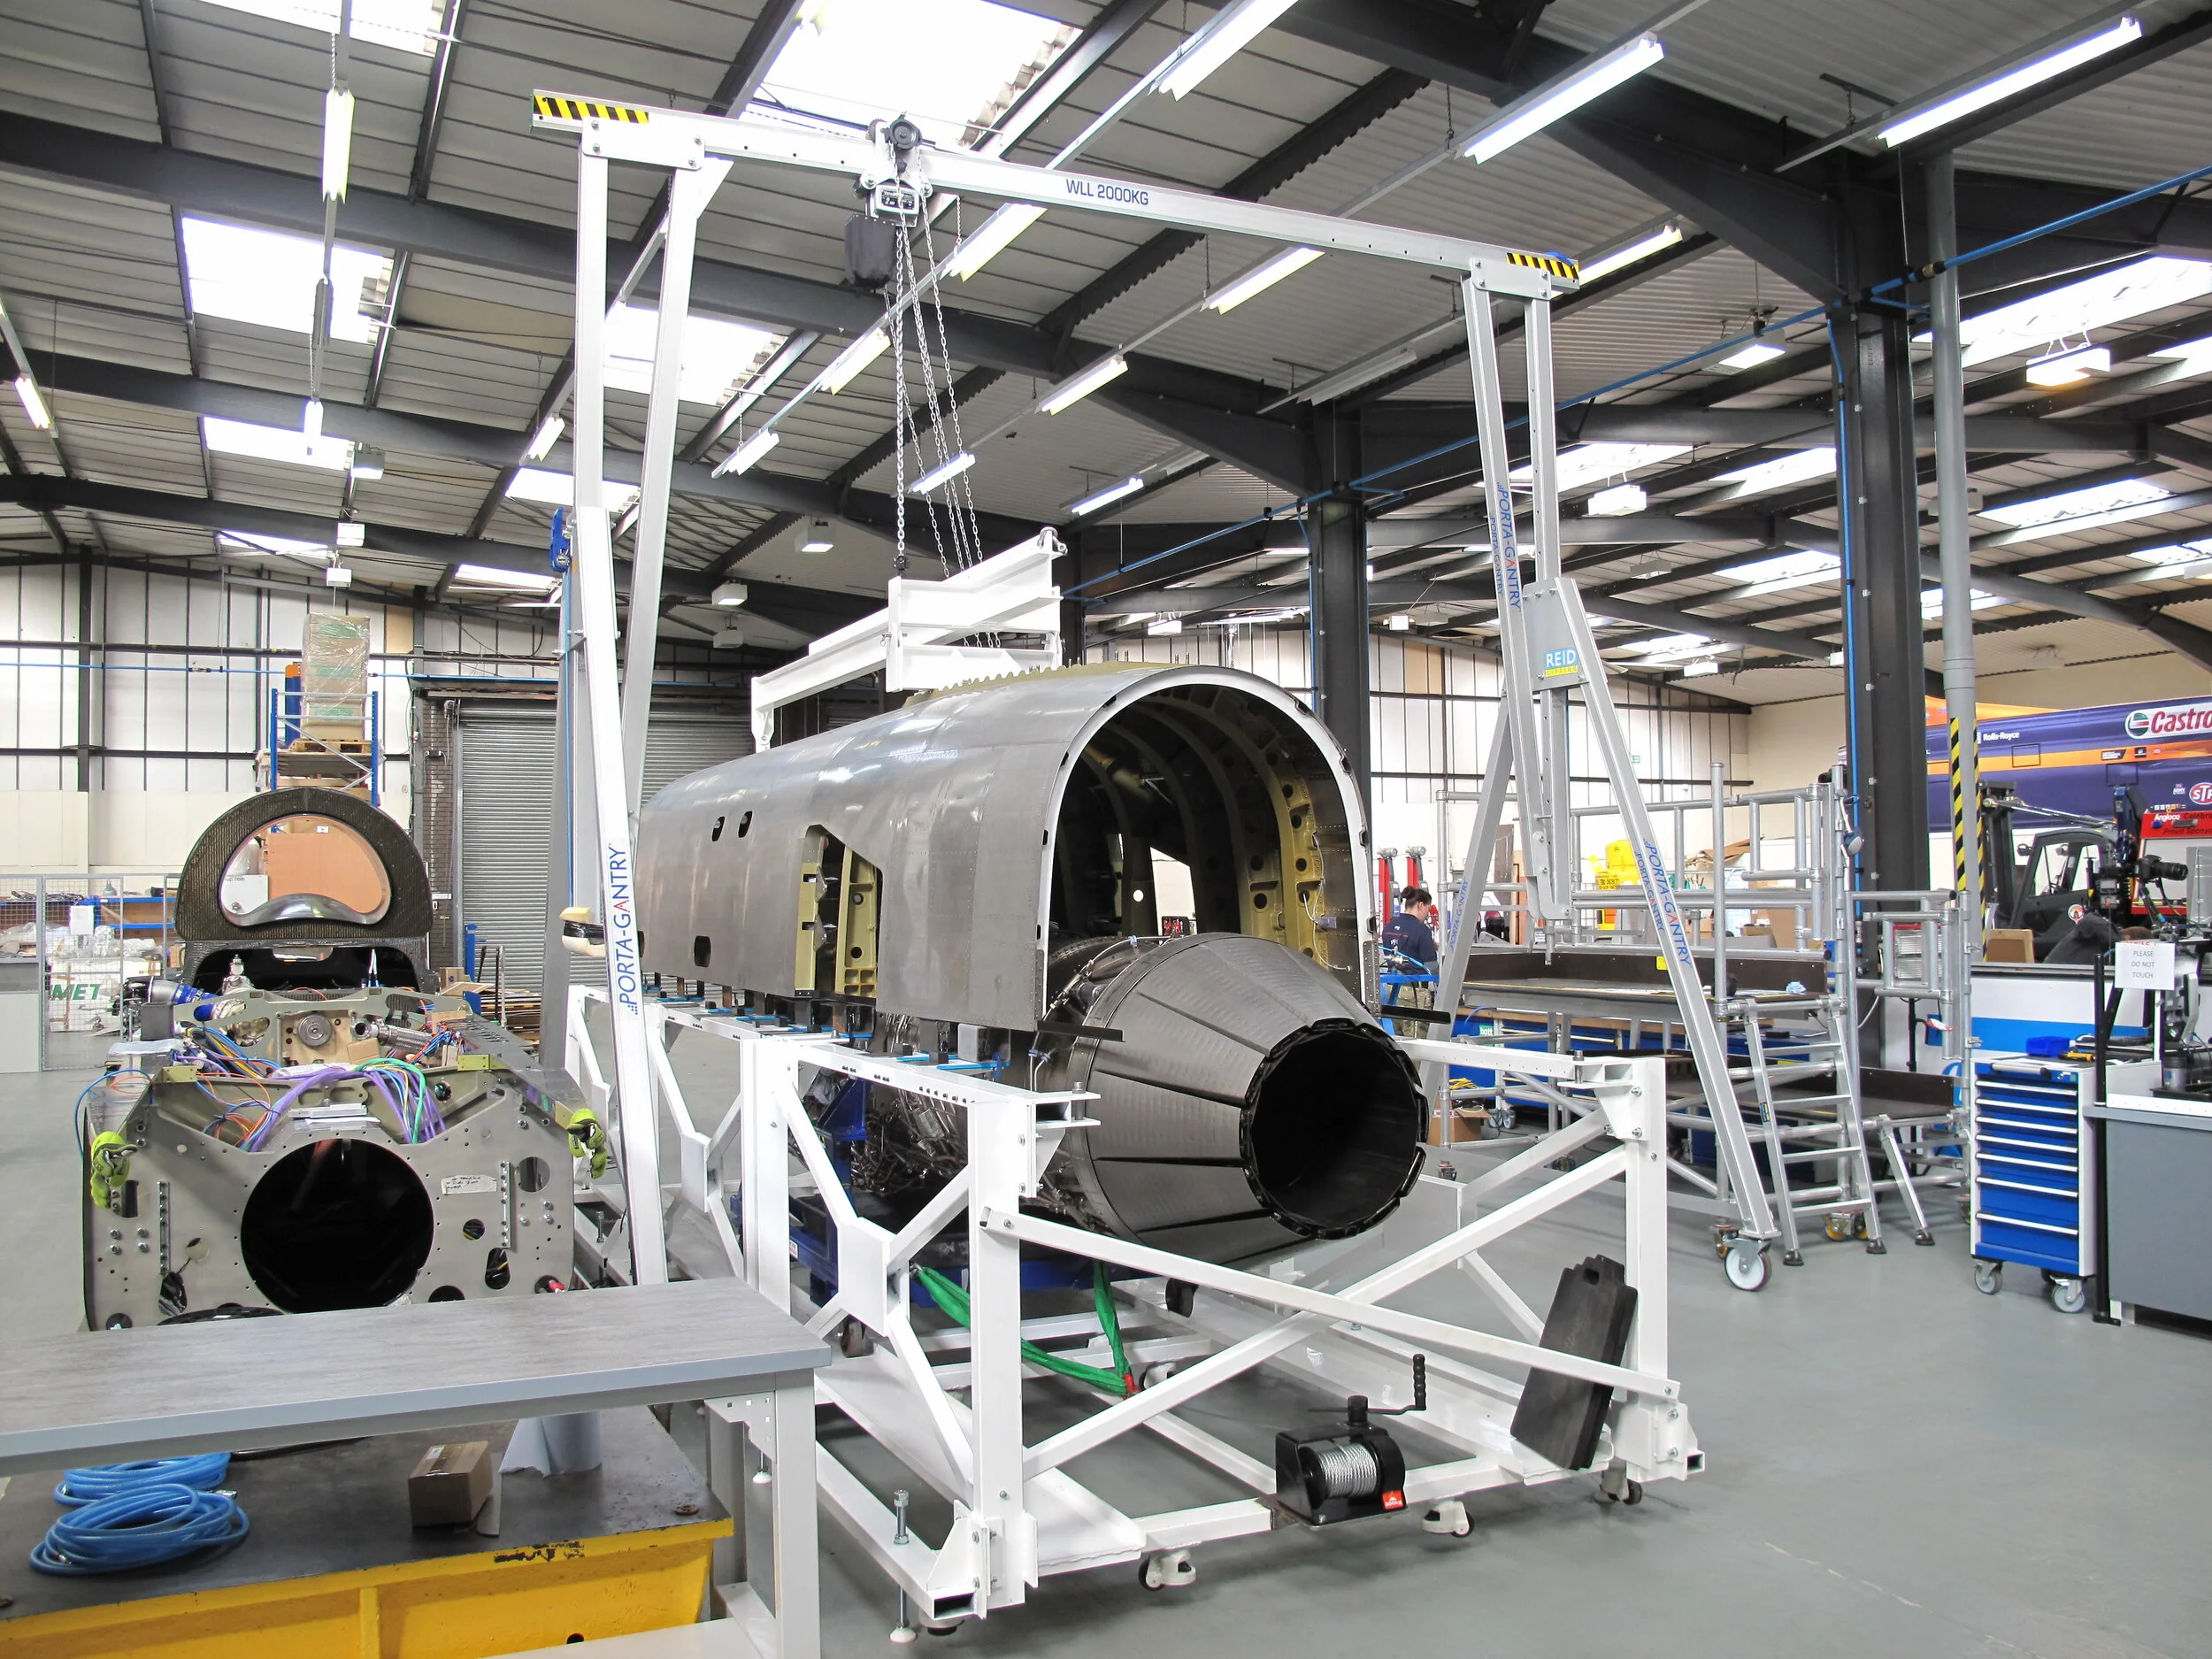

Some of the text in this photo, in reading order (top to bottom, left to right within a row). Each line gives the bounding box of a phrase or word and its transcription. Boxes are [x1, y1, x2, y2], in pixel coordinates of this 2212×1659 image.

[1065, 179, 1148, 205] WLL 2000KG
[1490, 517, 1503, 598] PORTA-GANTRY
[1499, 490, 1521, 610] PORTA-GANTRY
[1546, 649, 1576, 668] REID
[1983, 732, 2019, 741] Rolls-Royce
[2154, 813, 2181, 822] Angloco
[1636, 854, 1664, 931] PORTA-GANTRY
[1646, 845, 1692, 966] PORTA-GANTRY
[608, 846, 638, 1005] PORTA-GANTRY
[50, 984, 100, 1001] MET
